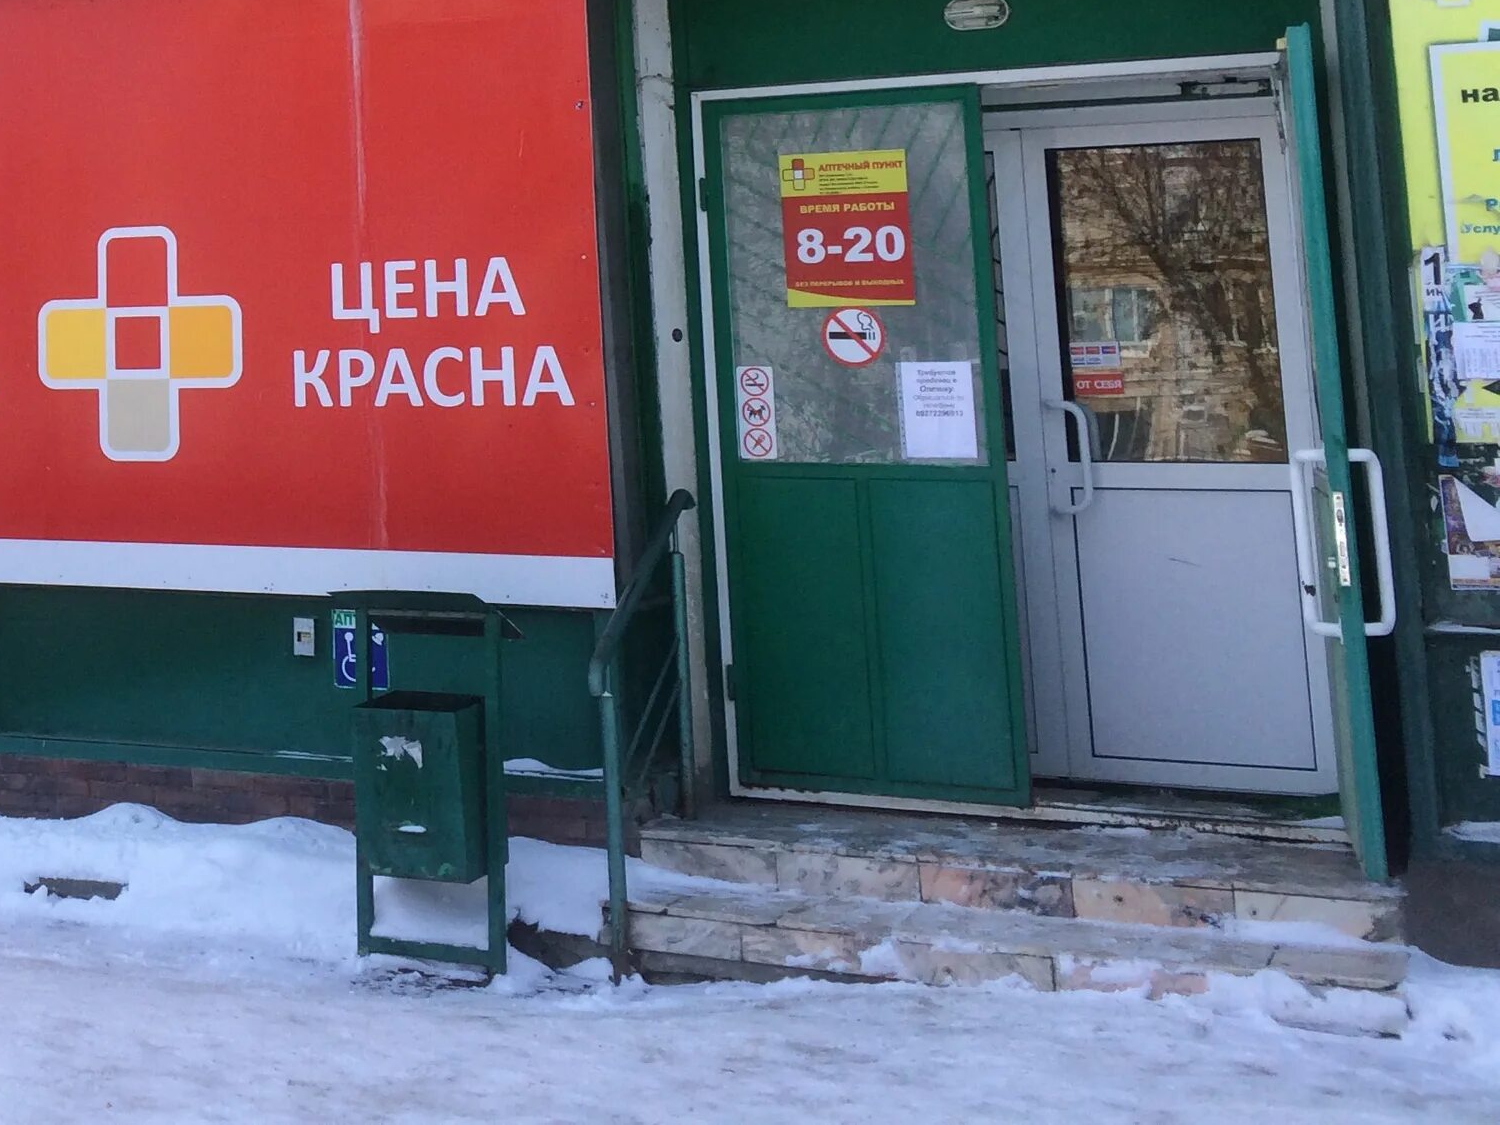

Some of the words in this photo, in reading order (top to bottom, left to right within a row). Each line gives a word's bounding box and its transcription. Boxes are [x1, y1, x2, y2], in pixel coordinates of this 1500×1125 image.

[819, 161, 870, 172] АПТЕЧНЫЙ
[872, 160, 903, 169] ПУНКТ
[800, 204, 840, 214] ВРЕМЯ
[843, 202, 895, 212] РАБОТЫ
[796, 224, 905, 264] 8-20
[331, 256, 526, 334] ЦЕНА
[293, 345, 575, 408] КРАСНА
[1076, 379, 1091, 389] ОТ
[1094, 379, 1122, 389] СЕБЯ
